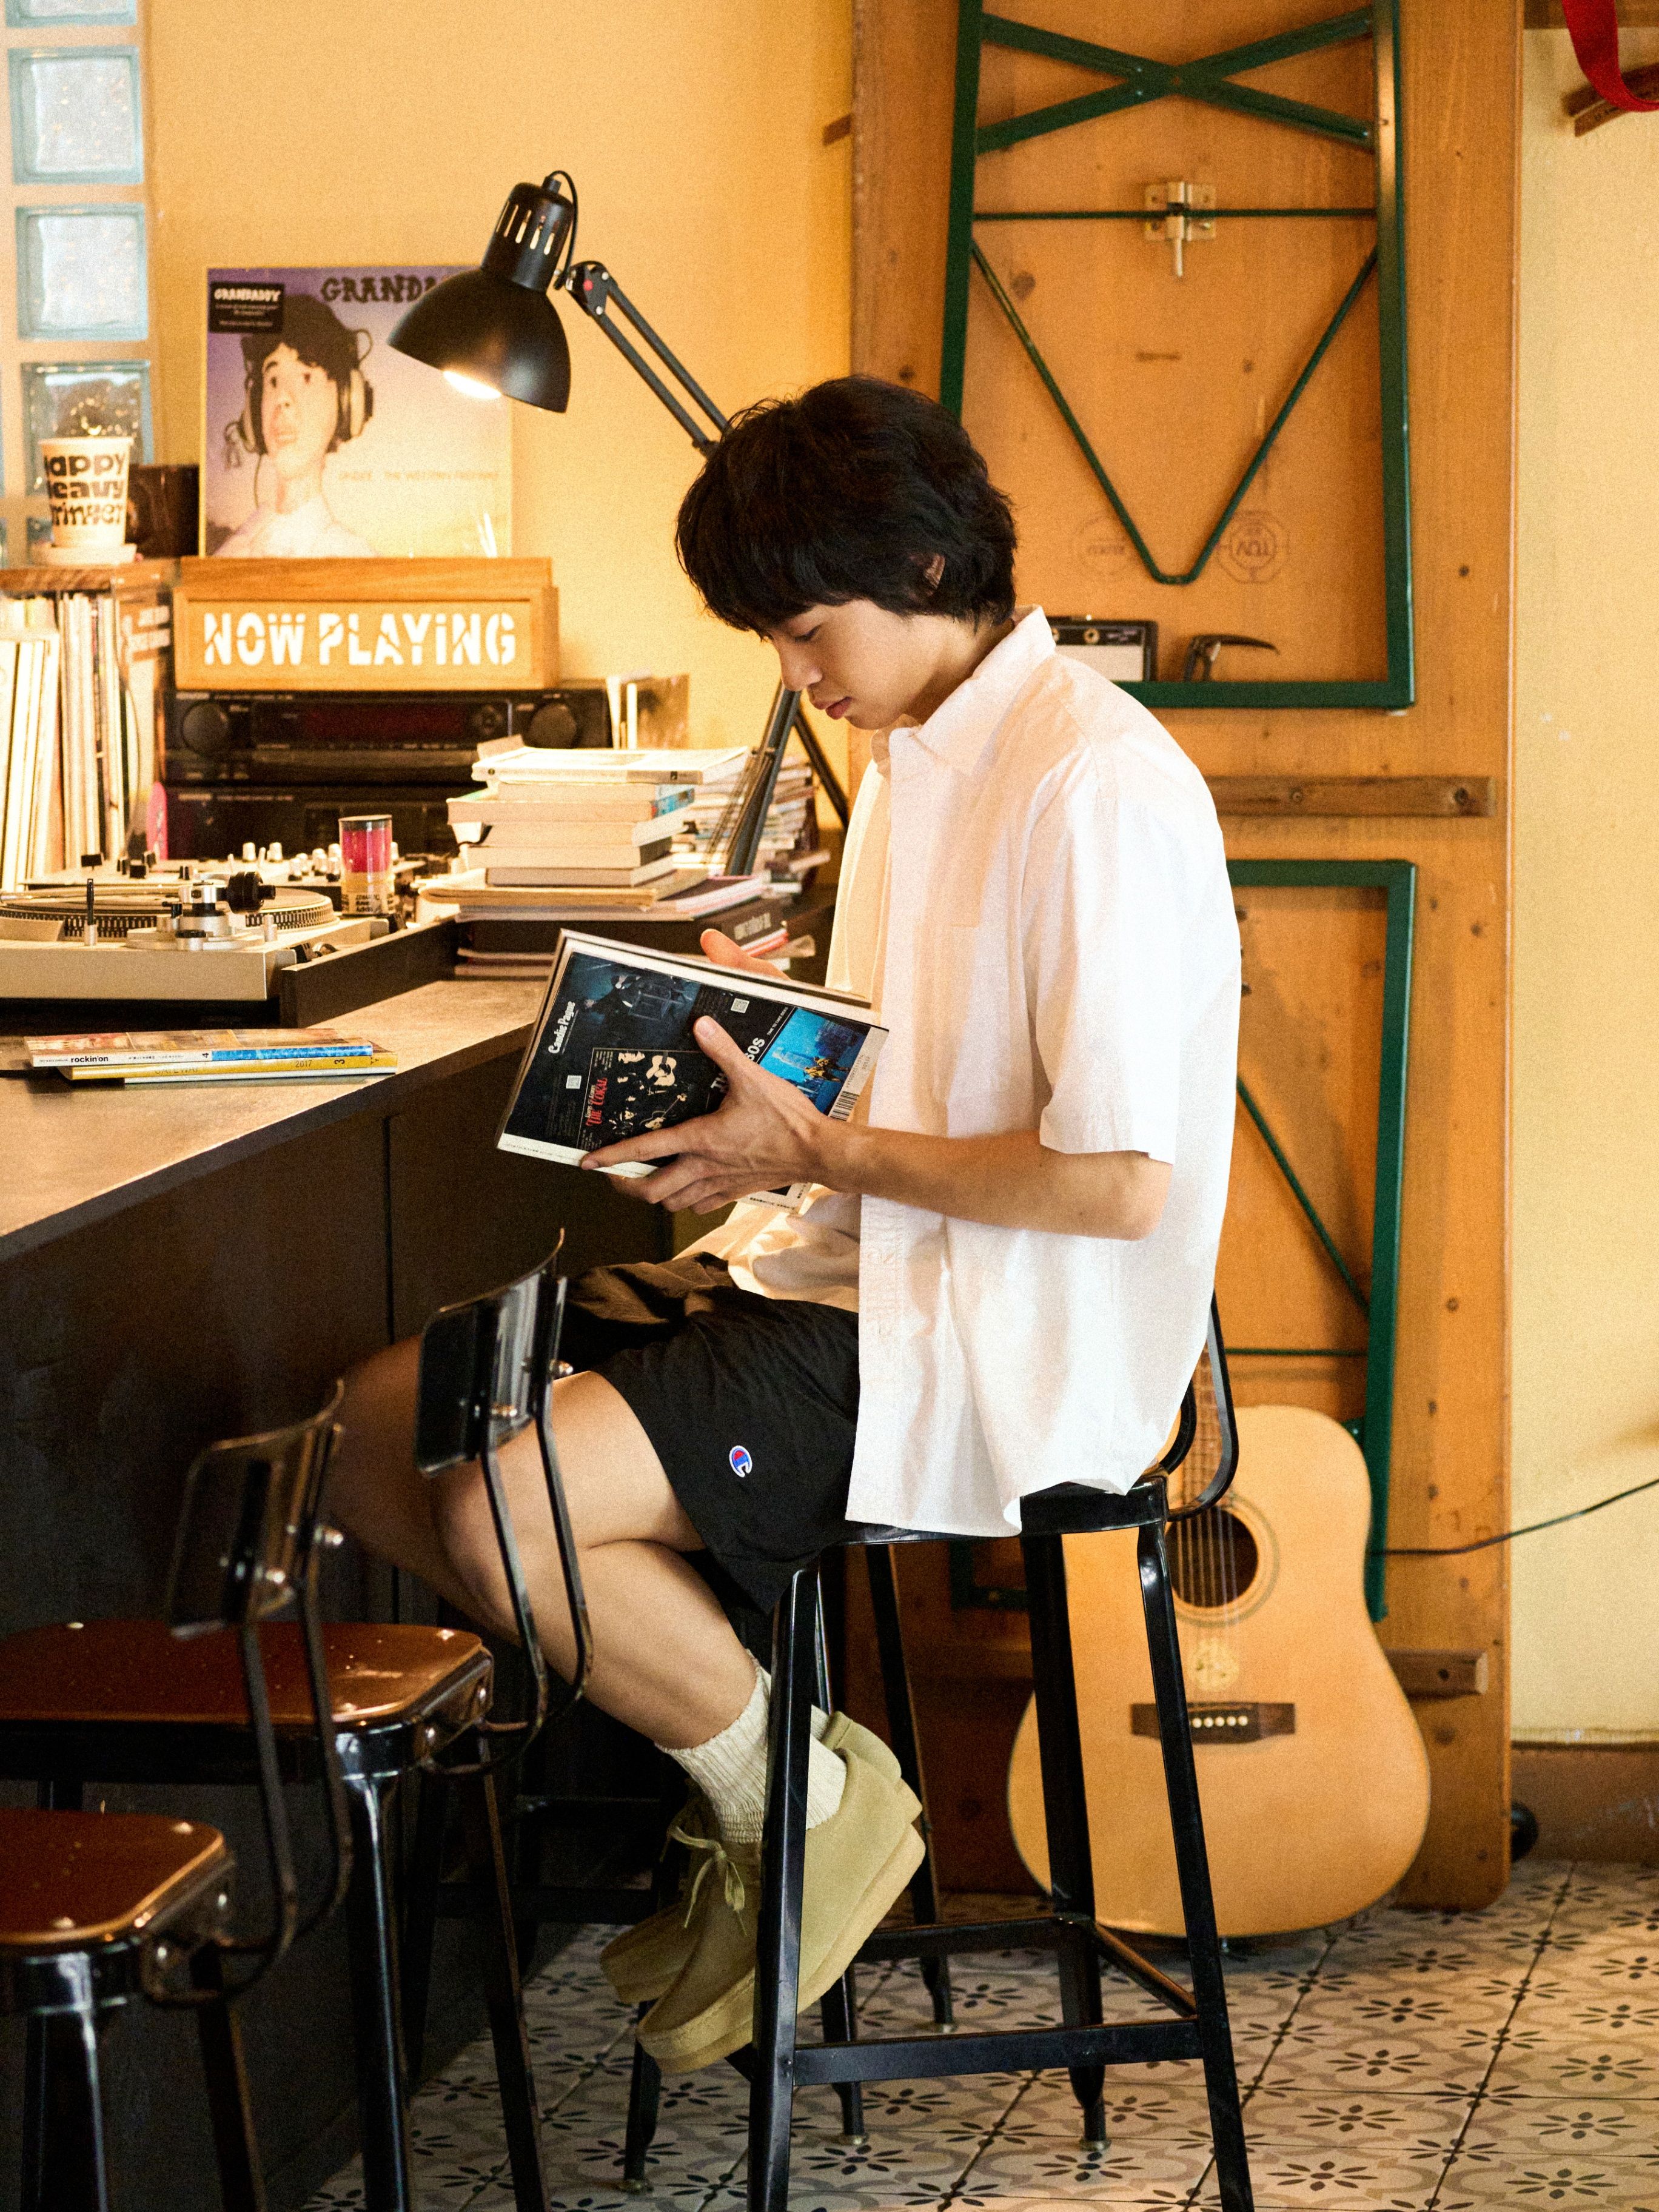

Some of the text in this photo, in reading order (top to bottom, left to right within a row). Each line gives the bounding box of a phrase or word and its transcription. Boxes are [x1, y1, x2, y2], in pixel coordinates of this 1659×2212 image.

[44, 454, 126, 477] appy
[47, 481, 125, 498] eavy
[204, 612, 517, 666] NOW PLAYING
